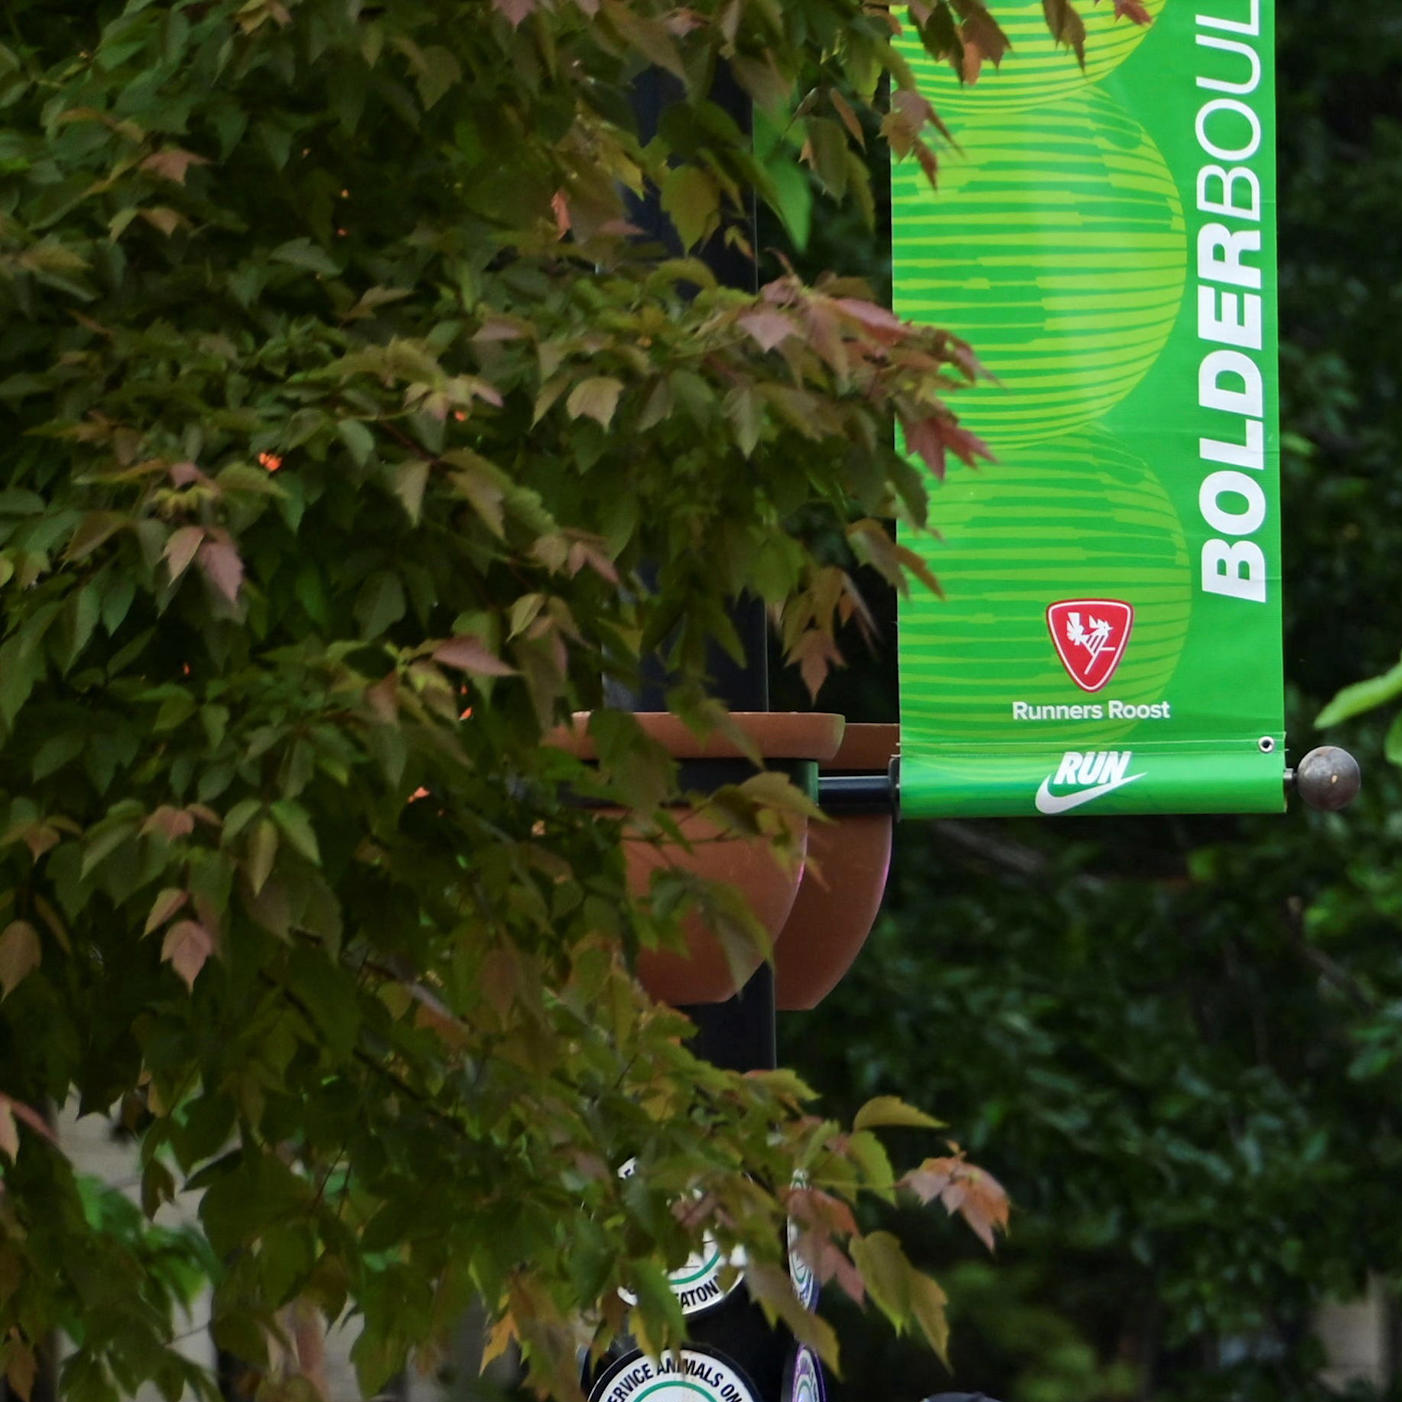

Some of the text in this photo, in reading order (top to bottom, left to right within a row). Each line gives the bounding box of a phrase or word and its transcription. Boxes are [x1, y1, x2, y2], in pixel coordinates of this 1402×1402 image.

[1012, 700, 1171, 720] Runners Roost
[1053, 751, 1133, 785] RUN
[675, 1274, 720, 1308] ATON
[656, 1357, 724, 1388] ANIMALS
